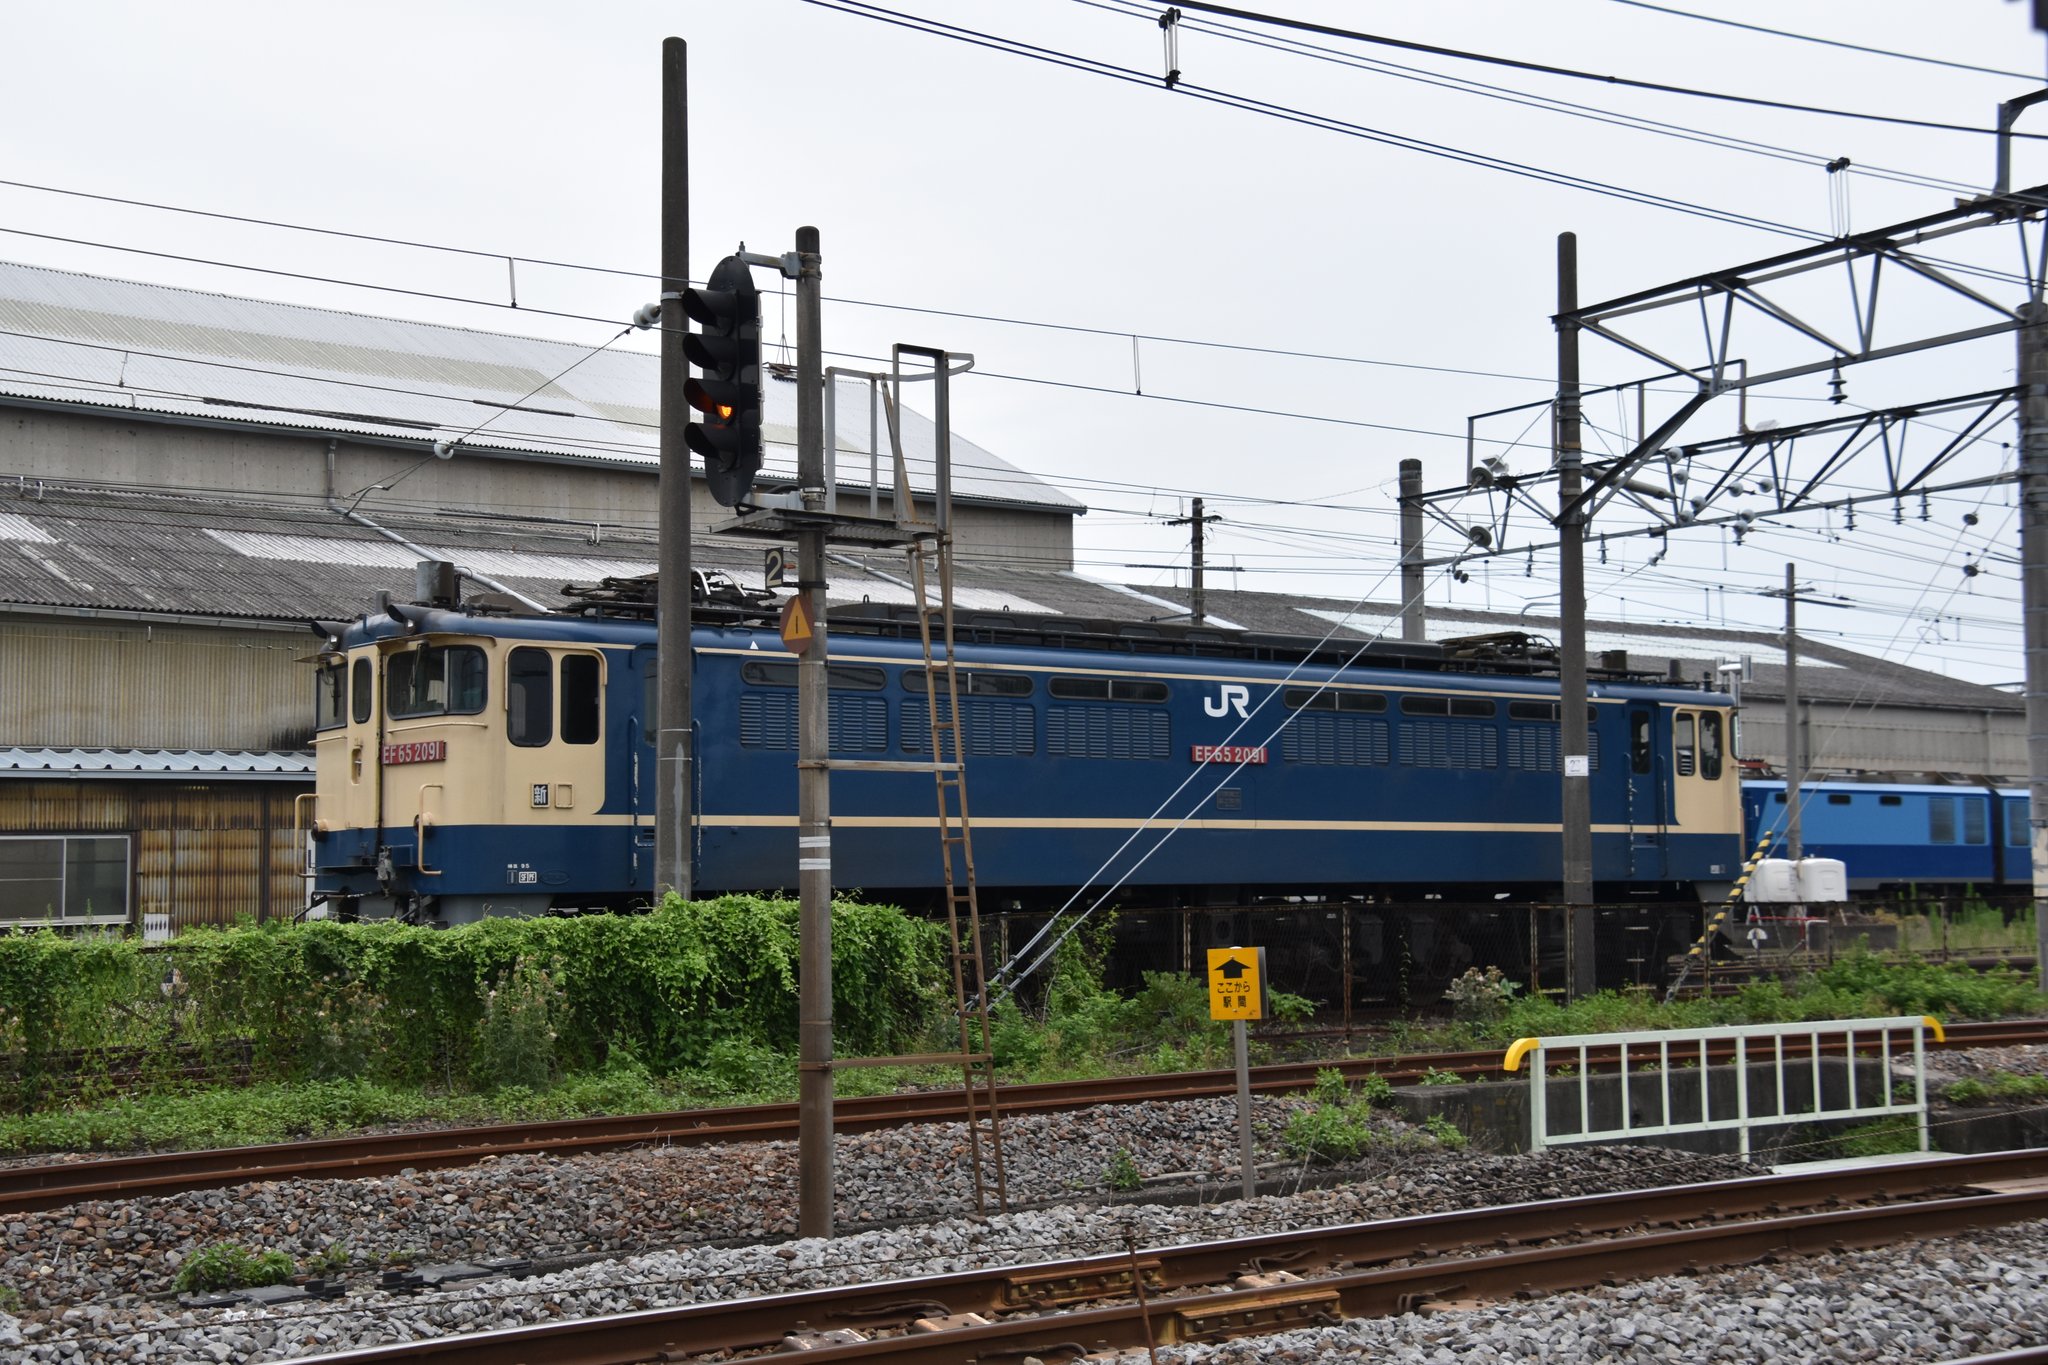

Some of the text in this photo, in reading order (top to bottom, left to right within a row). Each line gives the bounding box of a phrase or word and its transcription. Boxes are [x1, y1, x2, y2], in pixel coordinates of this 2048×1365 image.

[766, 550, 783, 587] 2
[1203, 684, 1250, 719] JR
[414, 741, 440, 762] 2091
[1234, 747, 1265, 763] 2091
[534, 785, 547, 804] 新
[1217, 981, 1251, 994] ここから
